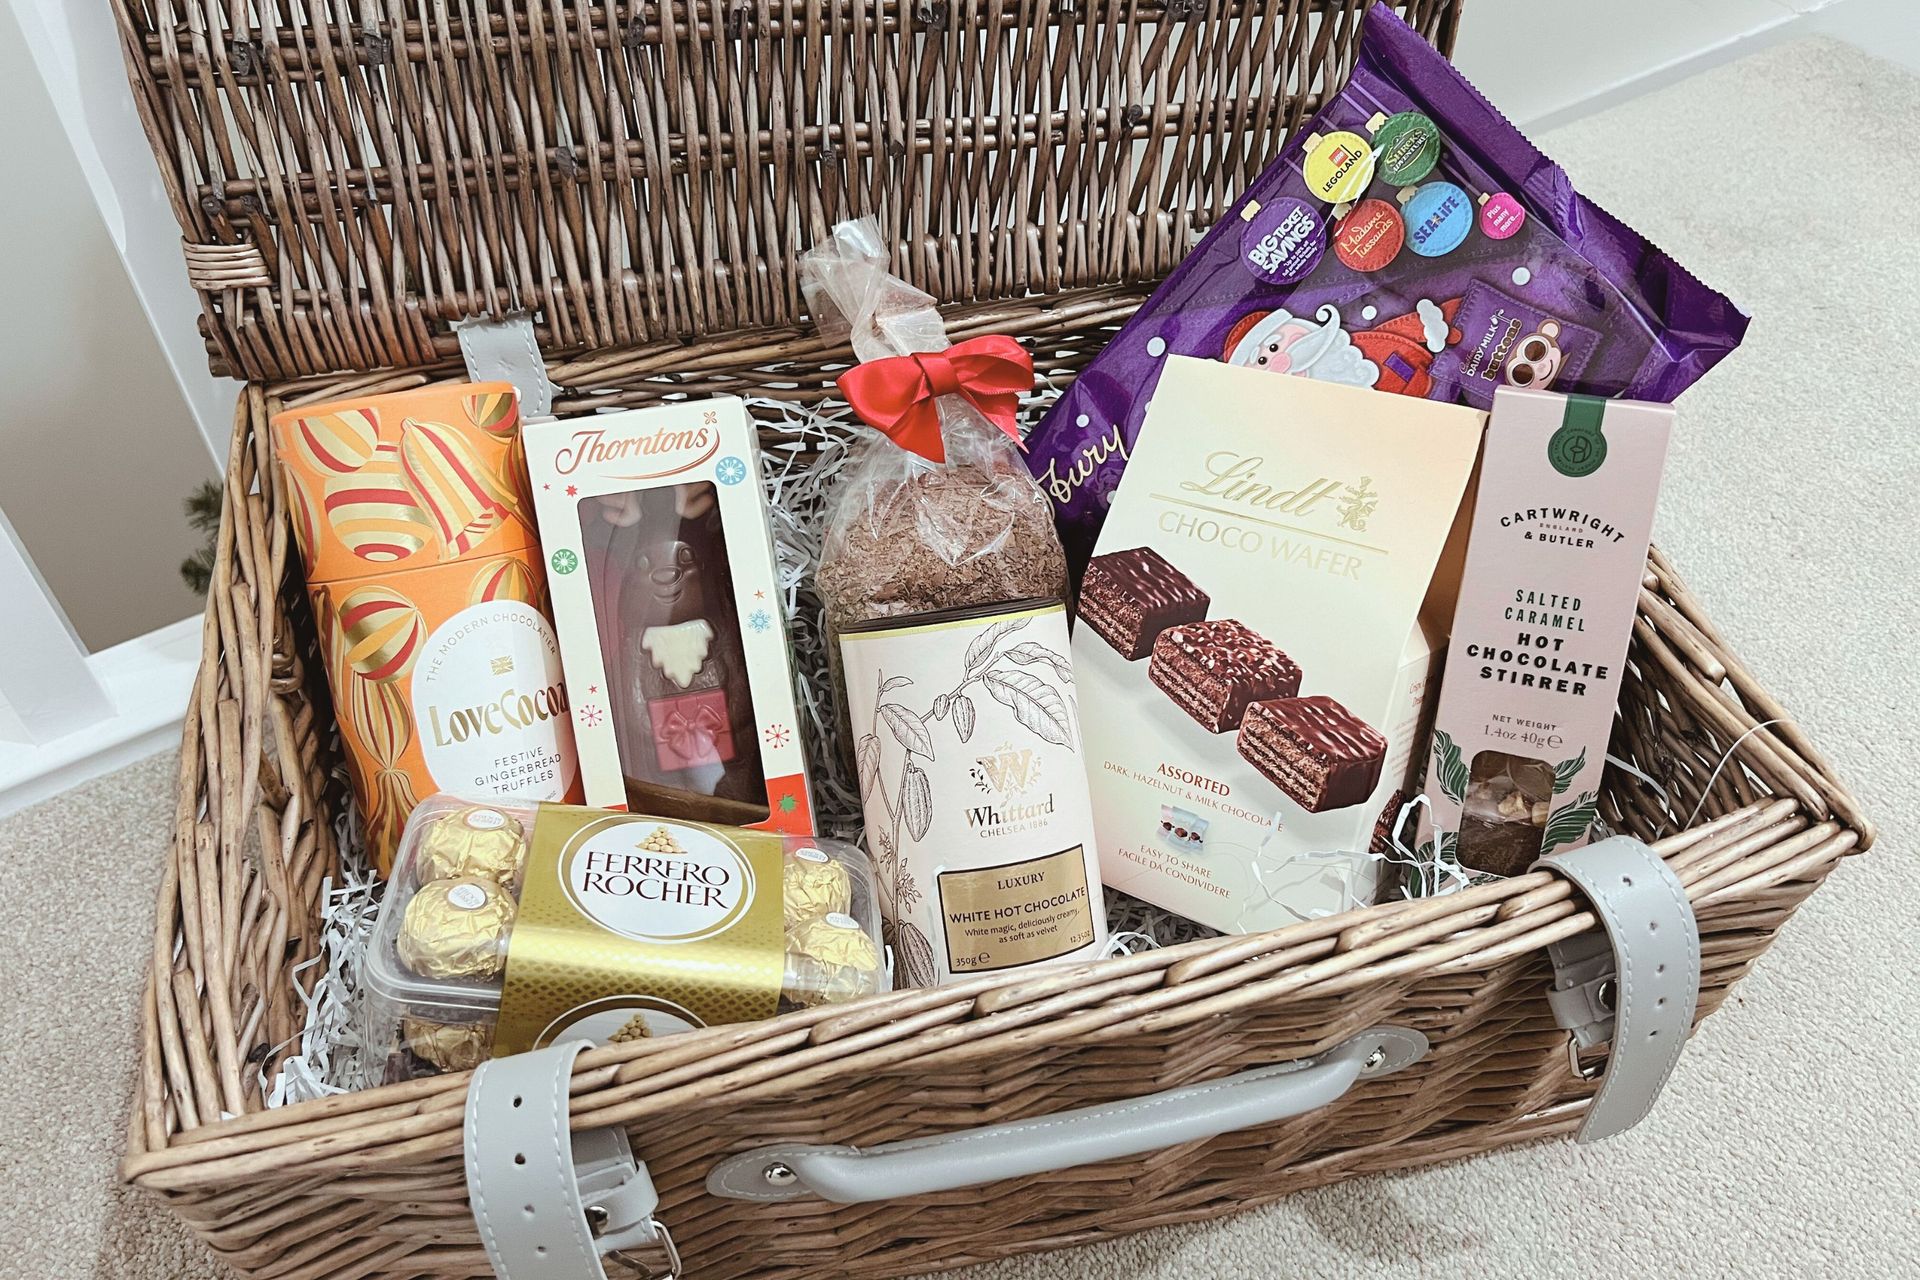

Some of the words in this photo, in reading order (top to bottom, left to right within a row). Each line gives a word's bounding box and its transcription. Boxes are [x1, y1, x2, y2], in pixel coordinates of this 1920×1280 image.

[1322, 148, 1362, 193] LEGOLAND
[1486, 205, 1501, 219] Plus
[1493, 208, 1510, 227] many
[1248, 234, 1278, 266] BIG
[1273, 206, 1303, 239] TICKET
[1340, 210, 1385, 253] Madame
[1350, 219, 1394, 259] Tussauds
[1413, 219, 1439, 244] SEA
[1466, 346, 1485, 377] DAIRY
[1480, 324, 1499, 349] MILK
[1481, 318, 1522, 381] buttons
[555, 427, 709, 475] Thorntons
[1037, 424, 1129, 520] bury
[1179, 451, 1344, 517] Lindt
[1500, 507, 1625, 543] CARTWRIGHT
[1524, 531, 1533, 540] &
[1539, 533, 1594, 549] BUTLER
[1539, 522, 1584, 534] ENGLAND
[1158, 511, 1263, 553] CHOCO
[1271, 536, 1363, 581] WAFER
[1515, 589, 1581, 612] SALTED
[1504, 607, 1585, 632] CARAMEL
[426, 657, 443, 683] THE
[439, 615, 489, 656] MODERN
[493, 613, 556, 655] CHOCOLATIER
[1517, 632, 1564, 651] HOT
[1466, 644, 1609, 680] CHOCOLATE
[1480, 666, 1587, 696] STIRRER
[1483, 724, 1517, 740] 1.4oz
[1492, 714, 1512, 724] NET
[1516, 718, 1557, 732] WEIGHT
[474, 753, 562, 787] GINGERBREAD
[494, 746, 544, 768] FESTIVE
[493, 769, 554, 795] TRUFFLES
[1157, 763, 1230, 797] ASSORTED
[963, 793, 1055, 829] Whittard
[1133, 771, 1183, 796] HAZELNUT
[1185, 791, 1192, 800] &
[1195, 794, 1219, 809] MILK
[1221, 803, 1284, 833] CHOCOLAE
[980, 822, 1025, 839] CHELSEA
[1029, 818, 1049, 830] 1886
[586, 851, 730, 886] FERRERO
[1118, 847, 1147, 866] FACILE
[1149, 860, 1163, 873] DA
[1165, 866, 1231, 899] CONDIVIDERE
[1140, 844, 1163, 859] EASY
[1165, 854, 1179, 866] TO
[1181, 859, 1212, 879] SHARE
[582, 871, 730, 910] ROCHER
[997, 872, 1046, 890] LUXURY
[949, 910, 991, 924] WHITE
[994, 904, 1022, 920] HOT
[1024, 886, 1086, 916] CHOCOLATE
[964, 925, 990, 938] White
[990, 922, 1017, 936] magic,
[1018, 914, 1056, 933] deliciously
[998, 936, 1006, 944] as
[1007, 931, 1026, 943] soft
[1026, 932, 1035, 940] as
[1036, 925, 1059, 938] velvet
[955, 954, 978, 968] 350g
